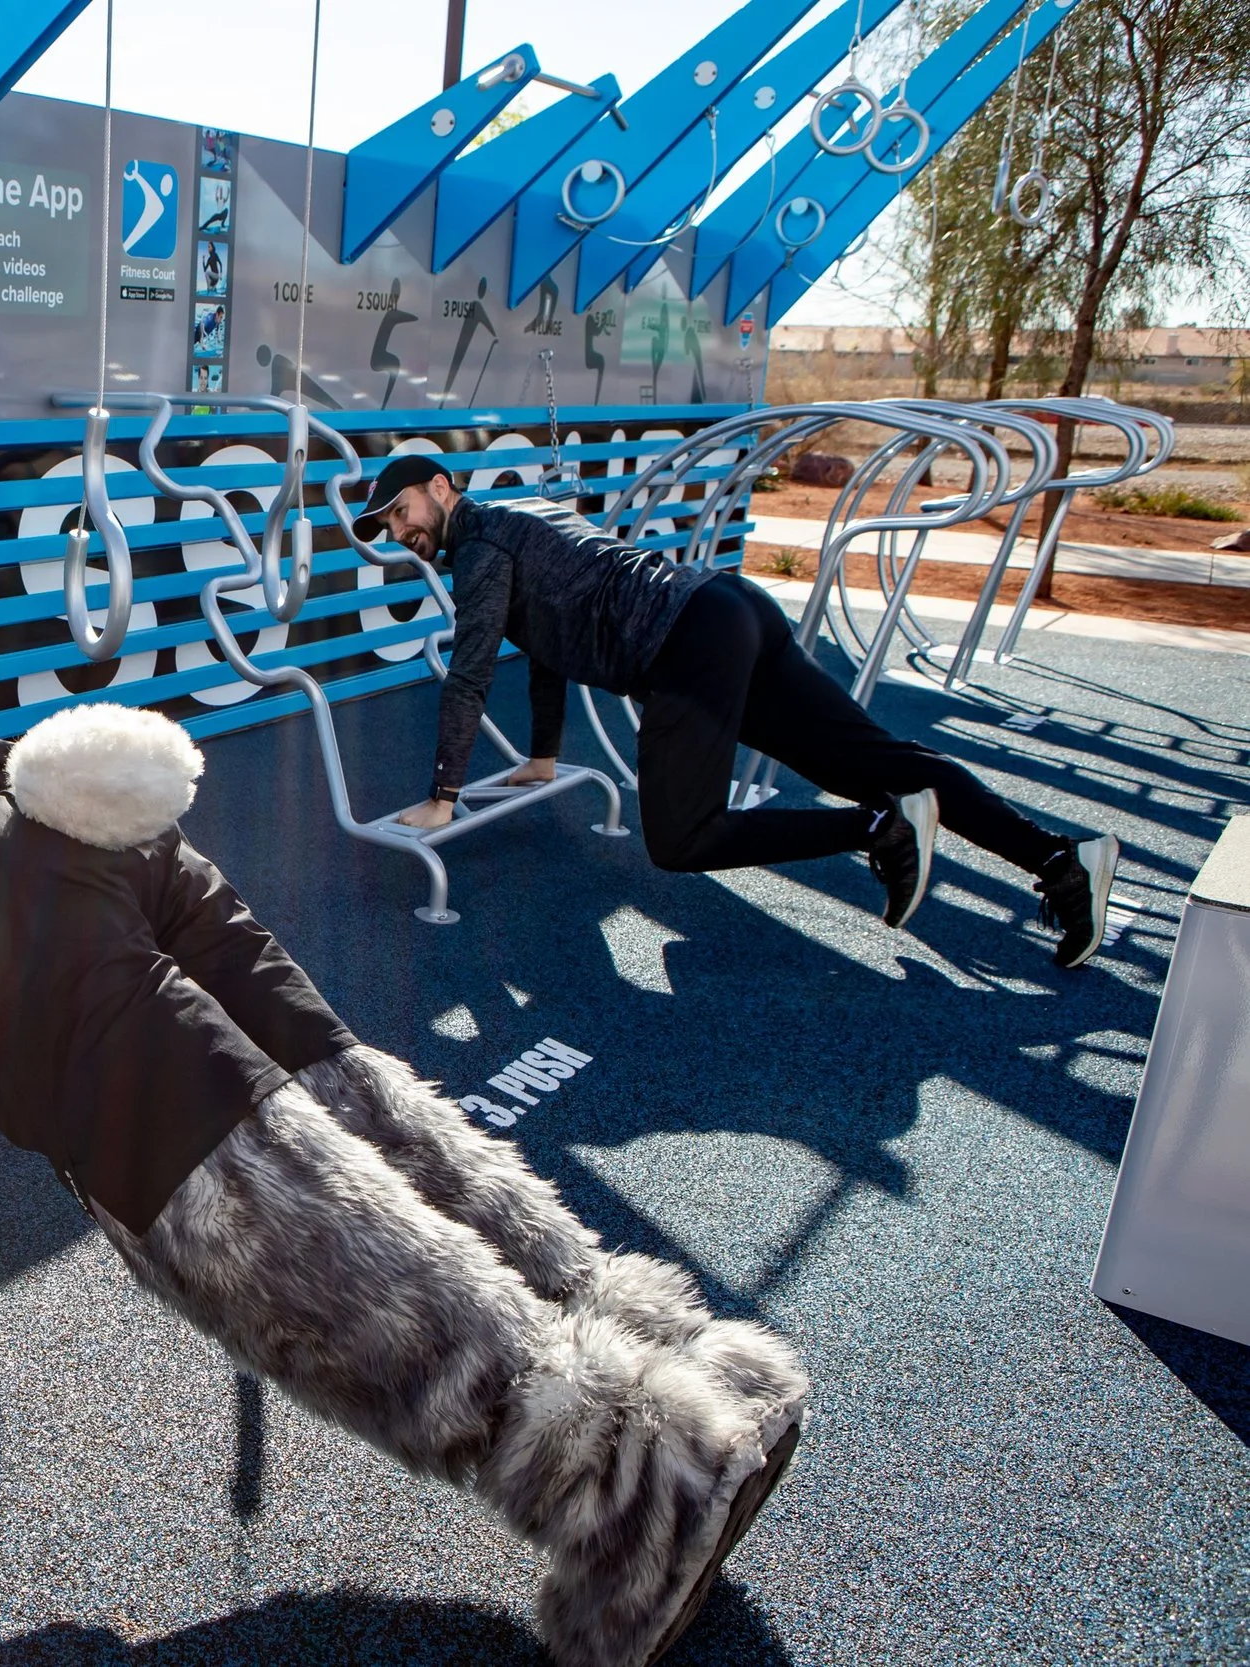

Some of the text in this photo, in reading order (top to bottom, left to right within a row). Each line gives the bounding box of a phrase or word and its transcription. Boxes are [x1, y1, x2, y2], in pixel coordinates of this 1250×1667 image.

[29, 174, 83, 220] App
[3, 260, 46, 277] videos
[121, 265, 175, 281] Fitness Court
[1, 285, 64, 308] challenge
[273, 282, 279, 301] 1
[357, 291, 400, 311] 2 SQUAT
[442, 300, 475, 319] 3 PUSH
[458, 1036, 594, 1128] 3. PUSH
